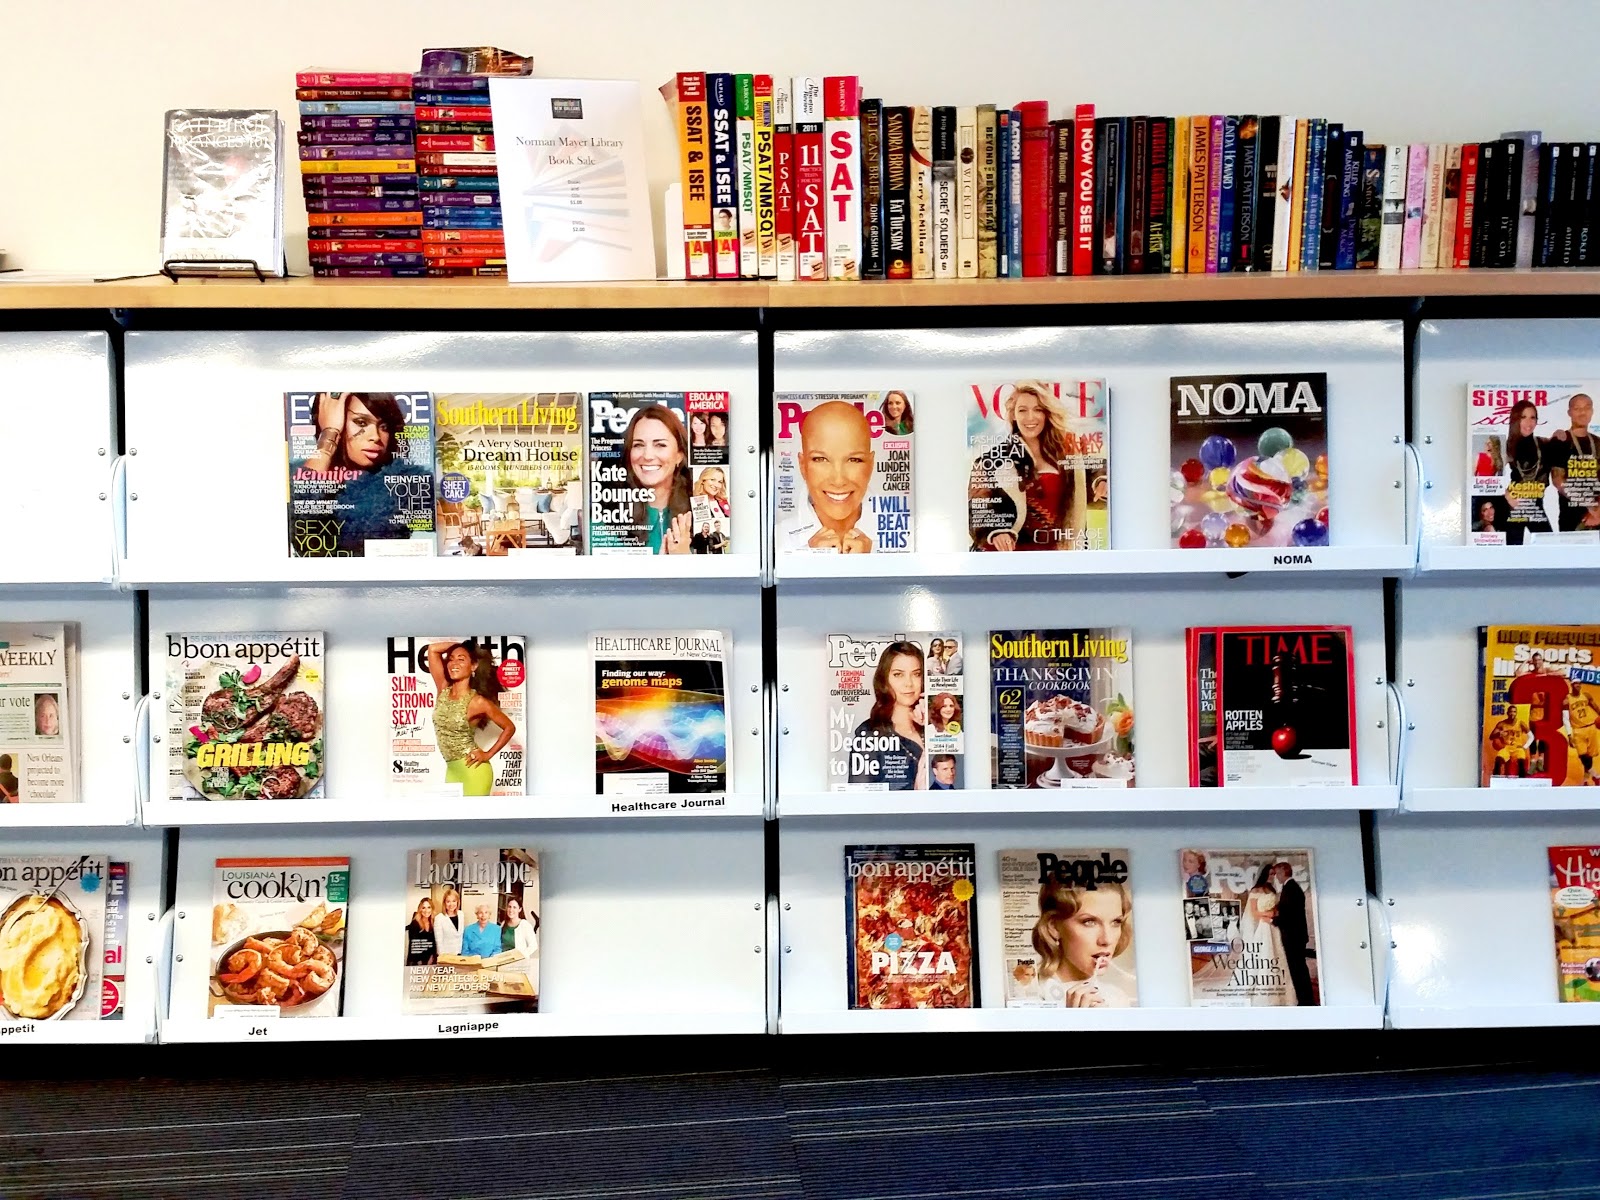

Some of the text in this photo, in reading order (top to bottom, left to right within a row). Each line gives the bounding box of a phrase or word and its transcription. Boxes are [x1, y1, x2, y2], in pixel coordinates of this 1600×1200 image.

[802, 124, 818, 132] 2011
[867, 109, 879, 162] PELICAN
[516, 136, 624, 149] Norman Mayer Library
[985, 126, 994, 165] BEYOND
[1011, 120, 1020, 160] ACTION
[686, 105, 705, 201] SSAT & ISEE
[714, 108, 732, 204] SSAT & ISEE
[800, 144, 822, 166] 11
[887, 113, 905, 191] SANDRA BROWN
[548, 155, 596, 166] Book Sale
[741, 132, 753, 214] PSAT/NMSQT
[830, 130, 854, 222] SAT
[1222, 150, 1237, 190] HOWARD
[1343, 148, 1353, 197] ARMSTRONG
[1192, 126, 1207, 232] JAMES PATTERSON
[963, 168, 972, 220] WICKED
[1079, 128, 1094, 251] NOW YOU SEE IT
[1240, 145, 1254, 241] JAMES PATTERSON
[801, 183, 823, 253] SAT
[940, 181, 949, 260] SECRET SOLDIERS
[1463, 205, 1474, 228] SINNED
[869, 203, 879, 258] JOHN GRISHAM
[889, 215, 905, 251] TUESDAY
[918, 203, 927, 254] McMillan
[689, 393, 724, 401] EBOLA IN
[689, 401, 724, 409] AMERICA
[1177, 381, 1322, 416] NOMA
[436, 400, 519, 426] Southern
[521, 400, 578, 432] Living
[403, 425, 430, 433] STAND
[477, 439, 563, 450] A Very Southern
[970, 434, 1020, 444] FASHION'S
[464, 448, 578, 462] Dream House
[888, 450, 910, 461] JOAN
[592, 461, 627, 482] Kate
[876, 462, 910, 472] LUNDEN
[971, 458, 1014, 470] MOOD
[1567, 459, 1598, 469] Shad
[292, 466, 363, 483] Jennifer
[384, 475, 431, 484] REINVENT
[886, 474, 910, 482] FIGHTS
[1567, 469, 1598, 478] Moss
[384, 483, 431, 498] YOUR
[443, 480, 466, 490] SHEET
[592, 482, 656, 503] Bounces
[882, 482, 910, 491] CANCER
[1508, 481, 1546, 491] Keshia
[444, 489, 465, 499] CAKE
[398, 497, 431, 511] LIFE
[878, 496, 910, 513] WILL
[592, 503, 634, 523] Back!
[294, 520, 346, 536] SEXY
[877, 514, 910, 531] BEAT
[1052, 528, 1077, 540] THE
[294, 535, 337, 551] YOU
[1273, 555, 1313, 565] NOMA
[182, 636, 320, 665] bon appétit
[595, 636, 722, 656] HEALTHCARE JOURNAL
[991, 633, 1128, 664] Southern Living
[1237, 634, 1333, 665] TIME
[701, 651, 722, 659] Orleans
[601, 670, 631, 678] Finding
[392, 676, 417, 692] SLIM
[602, 677, 683, 688] genome maps
[1028, 681, 1091, 691] COOKBOOK
[10, 697, 30, 708] vote
[392, 692, 434, 708] STRONG
[999, 689, 1022, 706] 62
[392, 709, 418, 725] SEXY
[830, 706, 855, 733] My
[1225, 710, 1263, 721] ROTTEN
[1225, 720, 1264, 731] APPLES
[830, 730, 900, 752] Decision
[27, 753, 64, 763] New Orleans
[196, 742, 311, 768] GRILLING
[499, 751, 522, 760] FOODS
[27, 766, 60, 776] projected to
[392, 759, 404, 774] 8
[404, 760, 419, 768] Healthy
[505, 760, 522, 768] THAT
[830, 753, 880, 776] to Die
[502, 769, 522, 778] FIGHT
[27, 778, 65, 787] become more
[495, 778, 522, 787] CANCER
[612, 797, 725, 812] Healthcare Journal
[222, 870, 277, 882] LOUISIANA
[414, 851, 534, 894] Lagniappe
[846, 855, 975, 883] bon appétit
[1036, 852, 1128, 891] People
[1231, 937, 1264, 954] Our
[410, 966, 430, 975] NEW
[871, 951, 957, 975] PIZZA
[1213, 954, 1280, 973] Wedding
[409, 975, 480, 983] NEW STRATEGIC
[1227, 969, 1287, 987] Album!
[409, 983, 447, 992] AND NEW
[248, 1026, 268, 1036] Jet
[438, 1021, 499, 1035] Lagniappe
